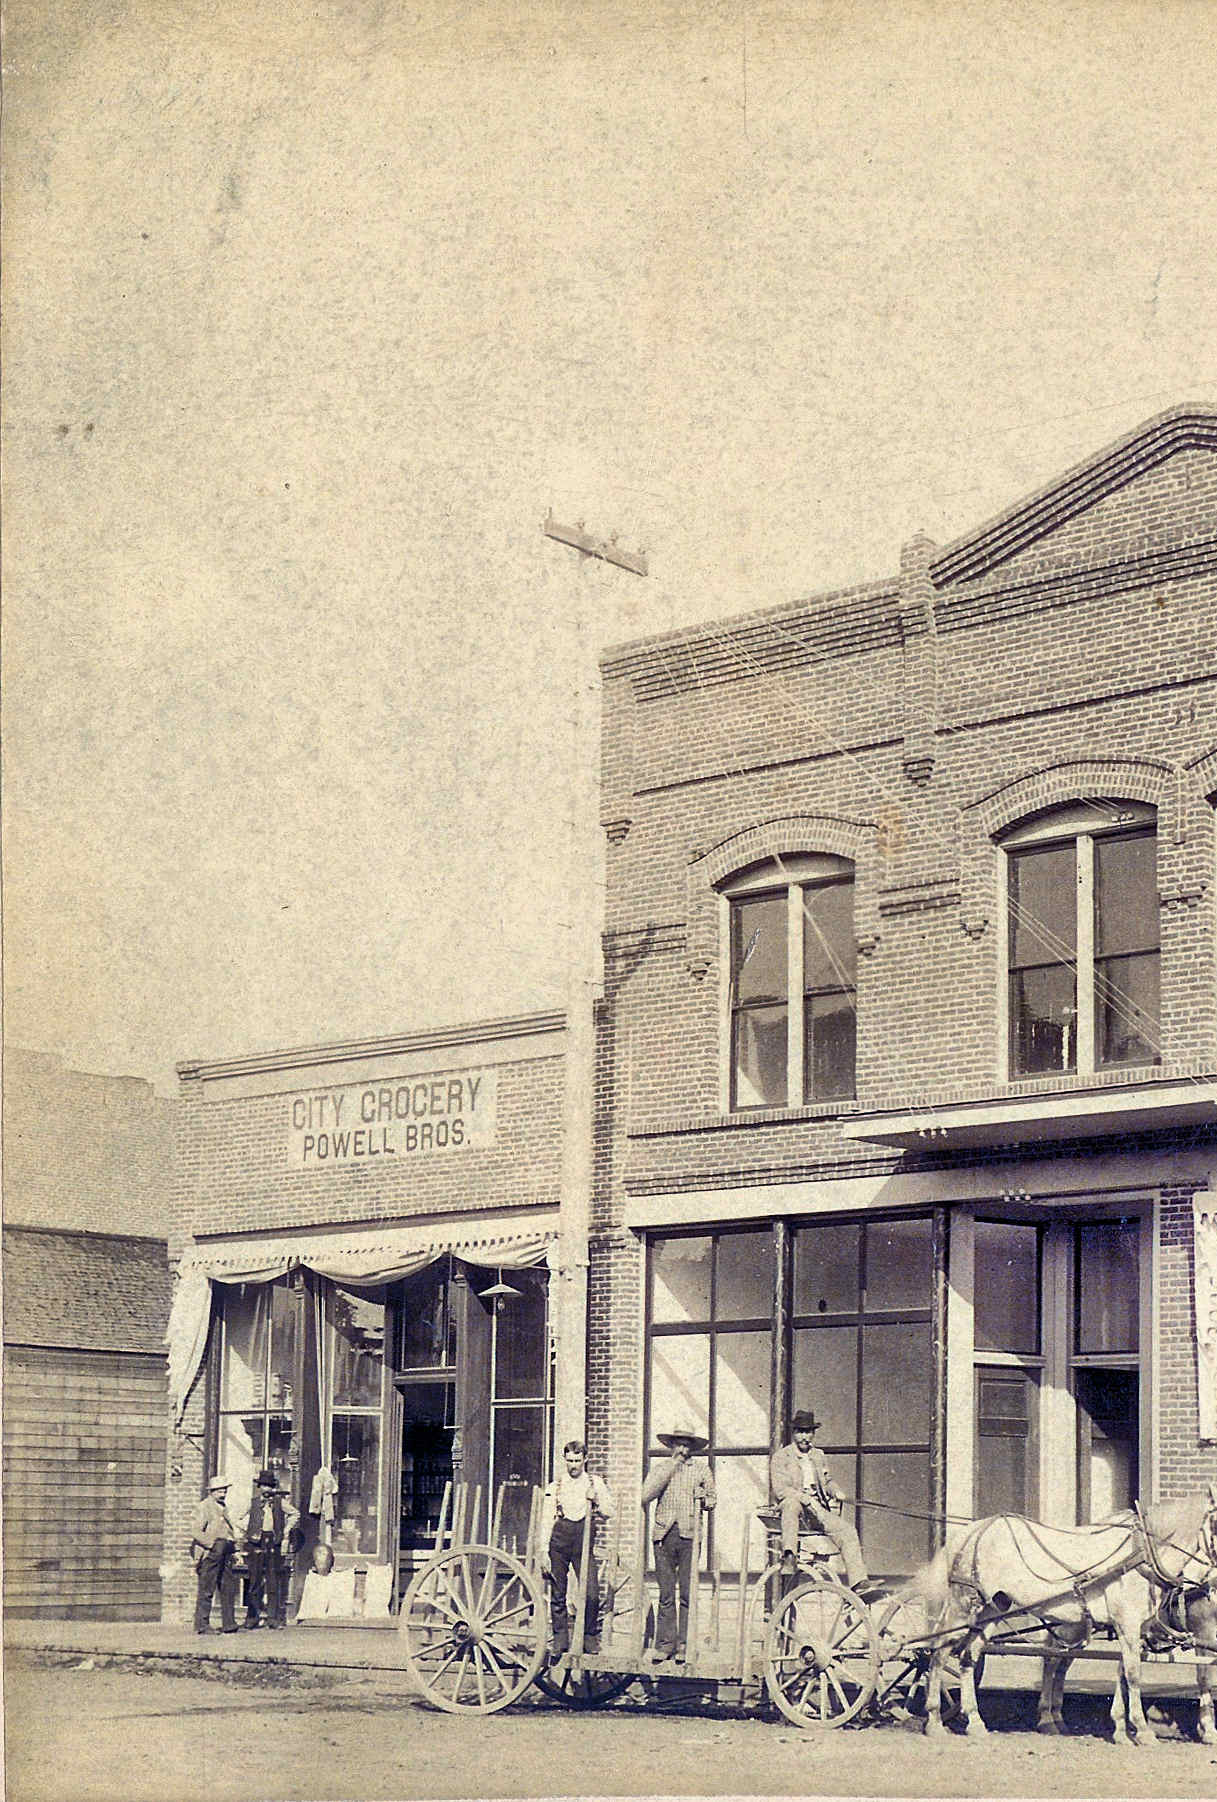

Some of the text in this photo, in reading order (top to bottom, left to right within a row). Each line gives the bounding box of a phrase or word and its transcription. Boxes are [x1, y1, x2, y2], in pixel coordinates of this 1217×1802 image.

[292, 1094, 344, 1129] CITY
[303, 1119, 471, 1161] POWELL BROS.
